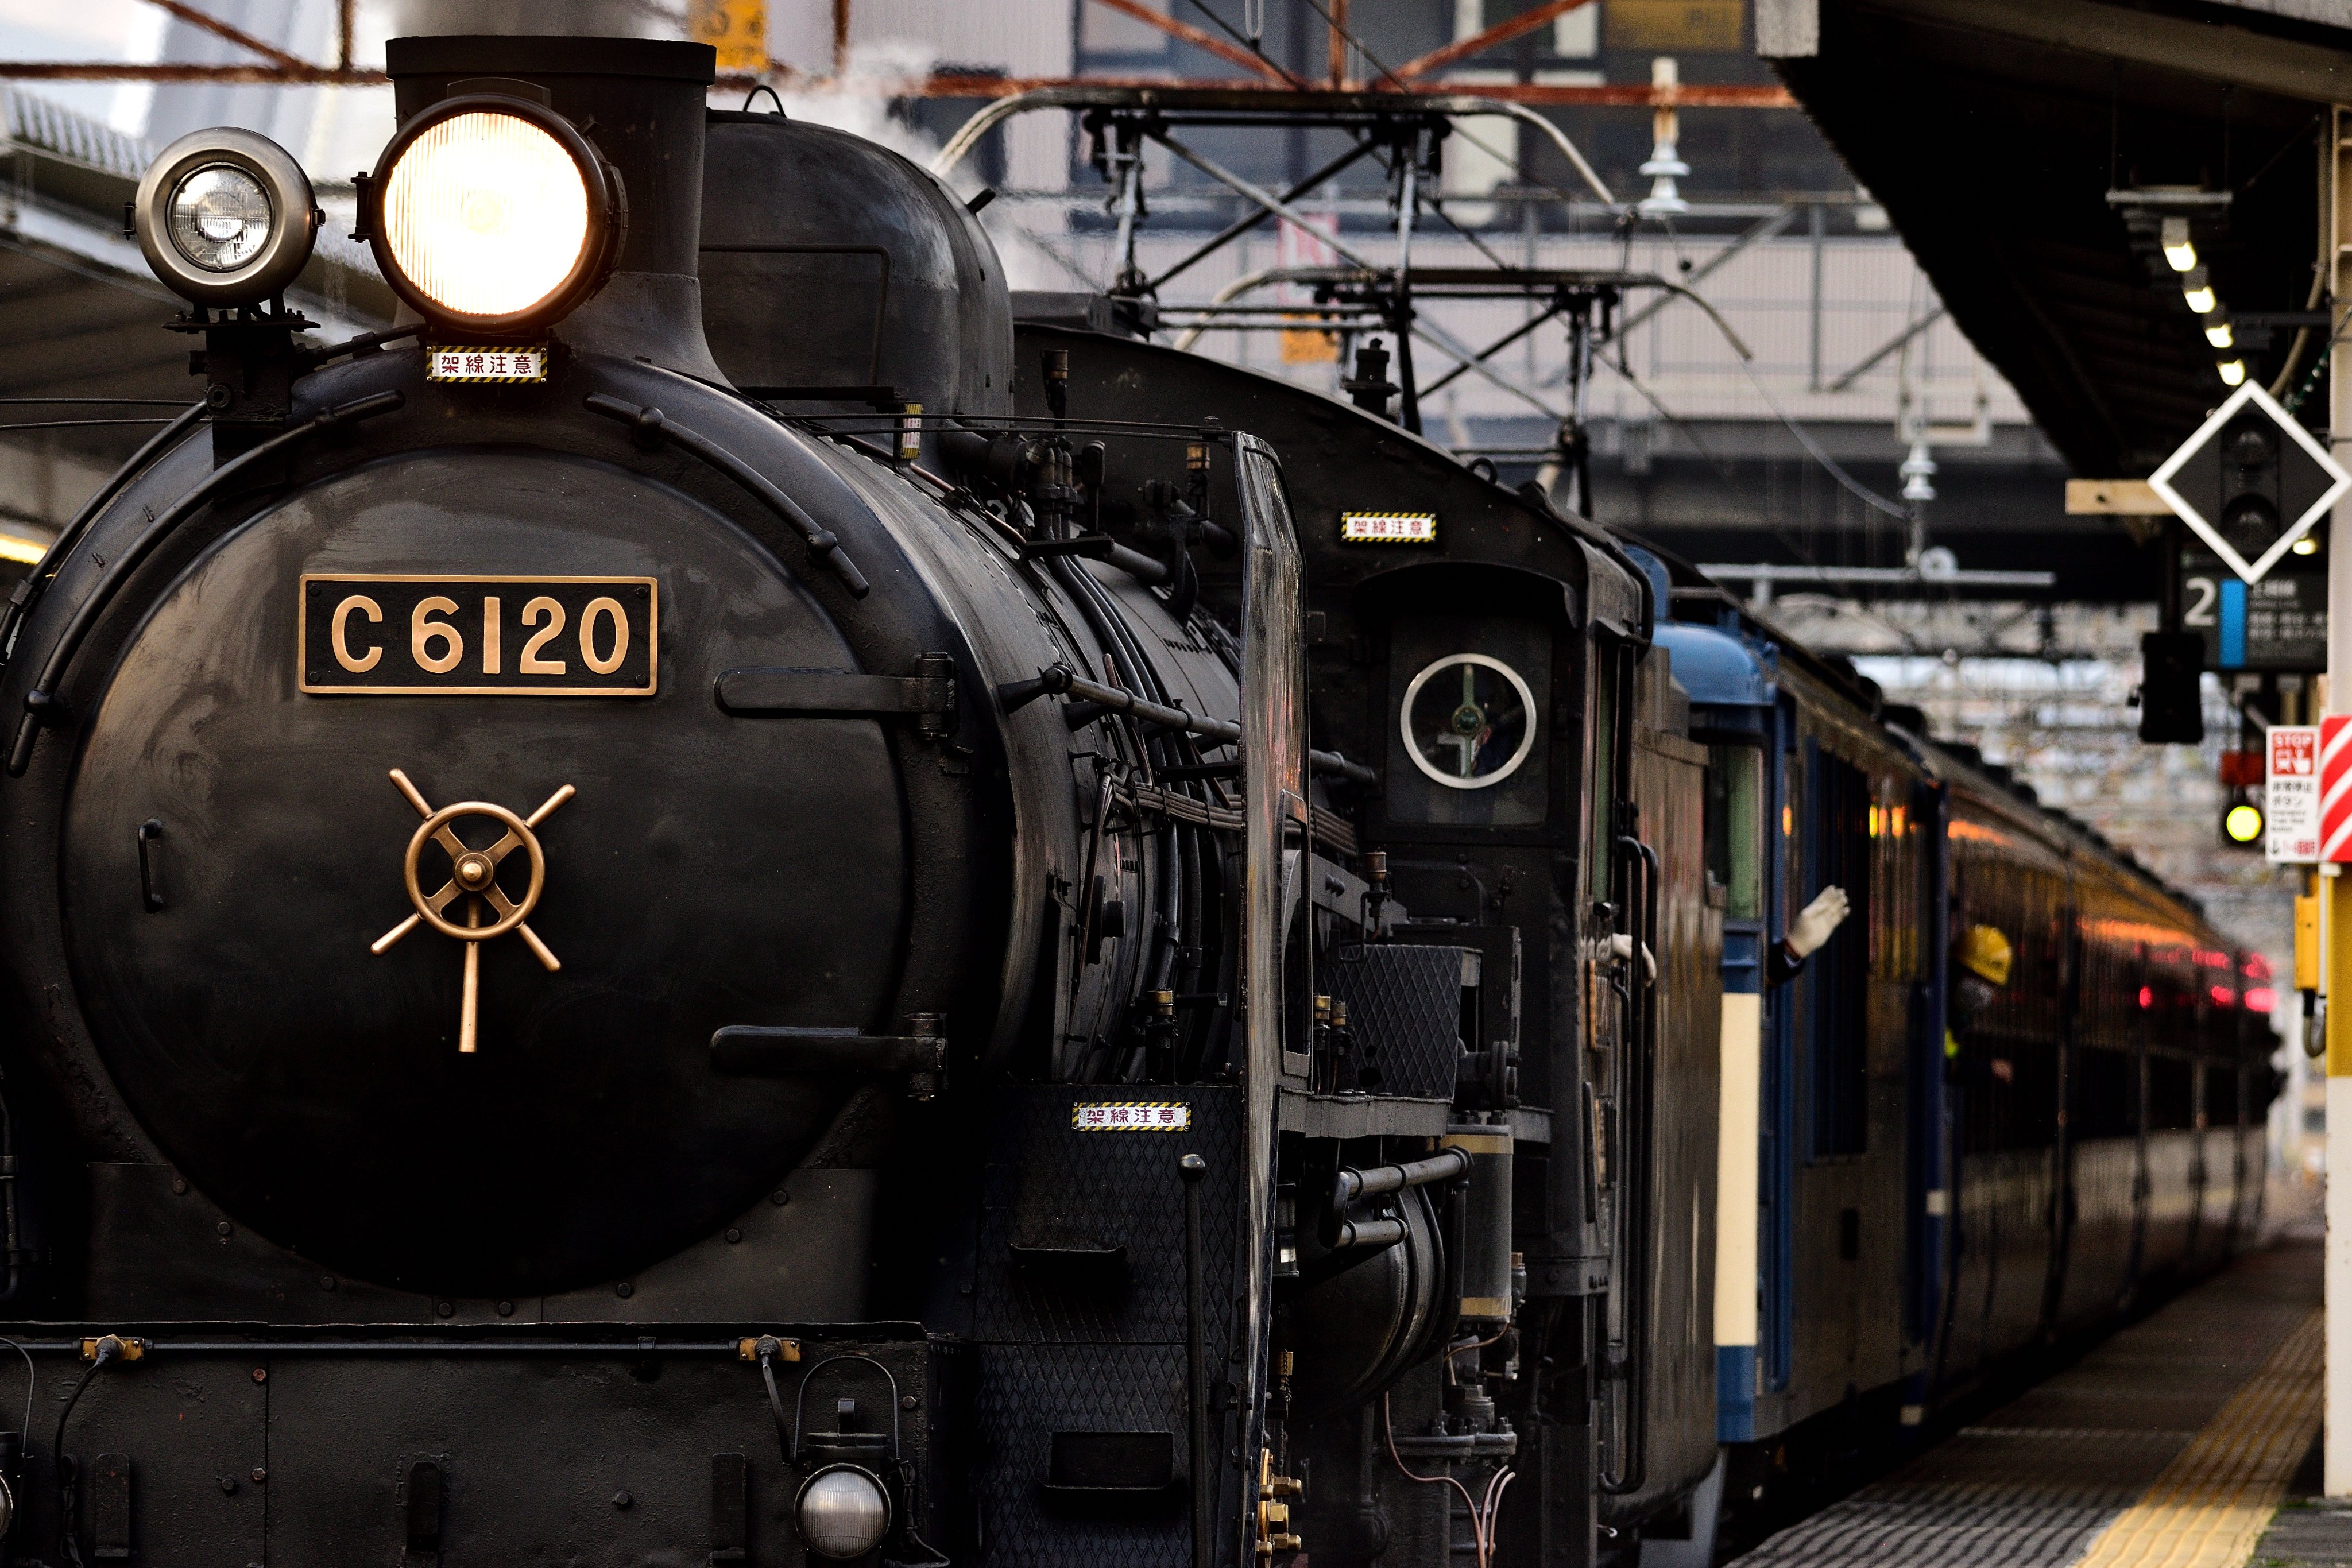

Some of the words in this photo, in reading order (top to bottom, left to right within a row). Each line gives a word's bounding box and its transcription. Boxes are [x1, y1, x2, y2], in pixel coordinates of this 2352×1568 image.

[441, 354, 532, 374] 架線注意
[1354, 520, 1423, 535] 架線注意
[2184, 577, 2217, 626] 2
[2273, 733, 2313, 748] STOP
[1087, 1108, 1175, 1124] 架線注意
